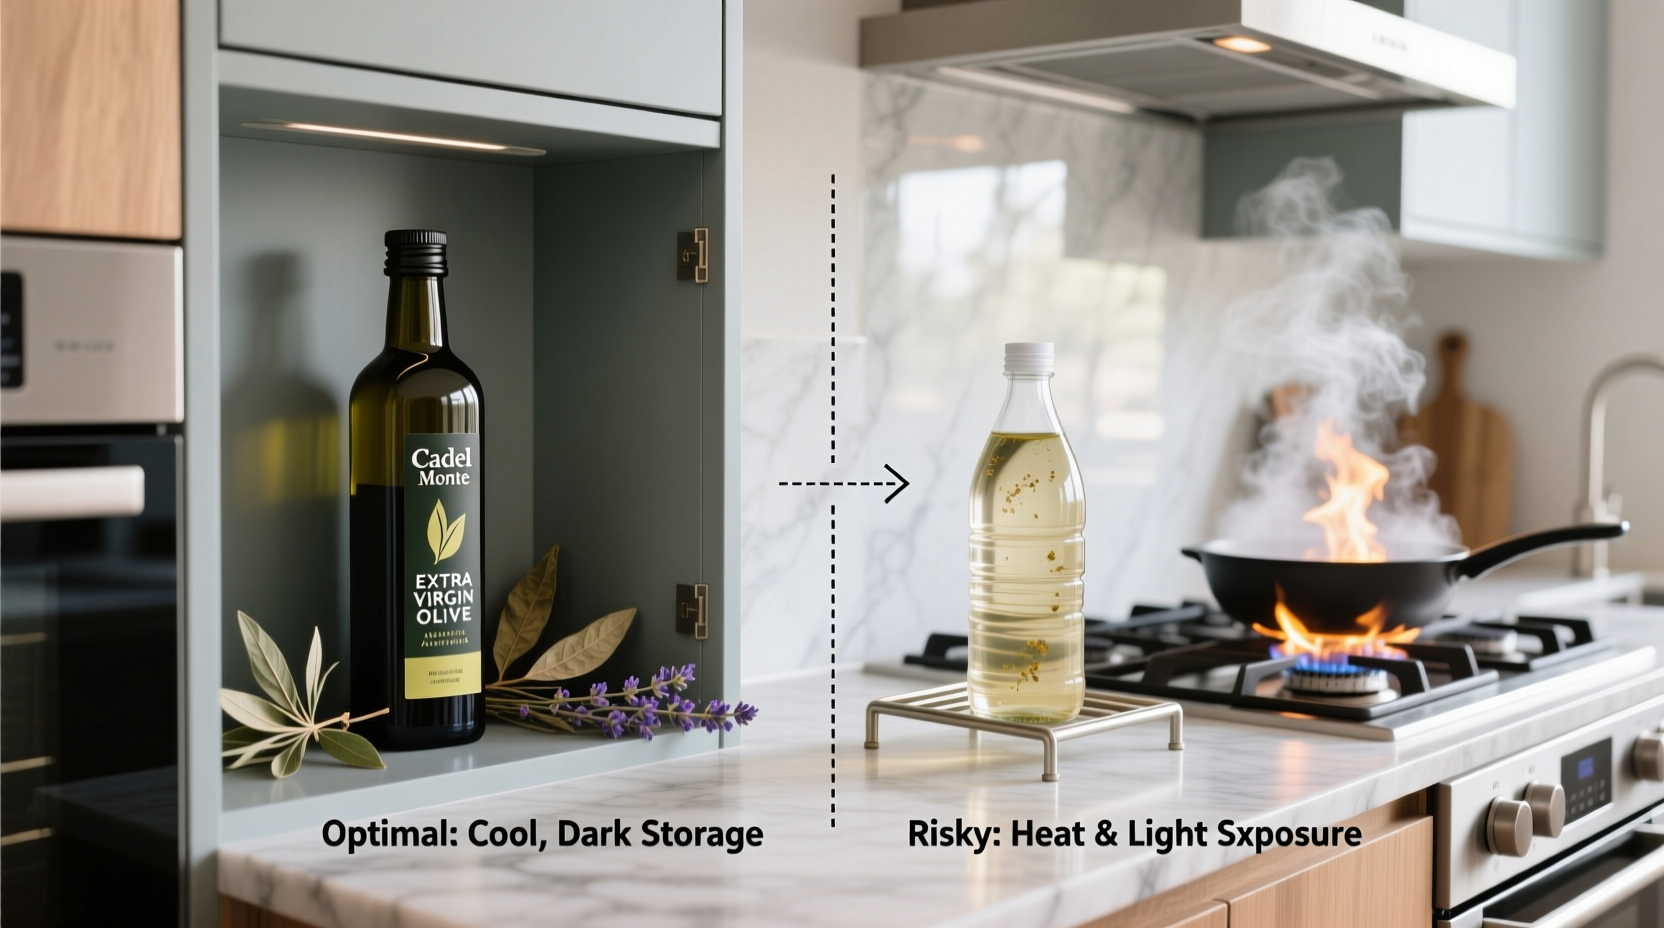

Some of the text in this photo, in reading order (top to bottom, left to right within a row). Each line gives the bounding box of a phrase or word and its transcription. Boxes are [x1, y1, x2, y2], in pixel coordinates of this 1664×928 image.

[411, 447, 472, 469] Cadel
[418, 469, 471, 486] Monte
[415, 571, 473, 589] EXTRA
[413, 588, 474, 608] VIRGIN
[416, 605, 472, 625] OLIVE
